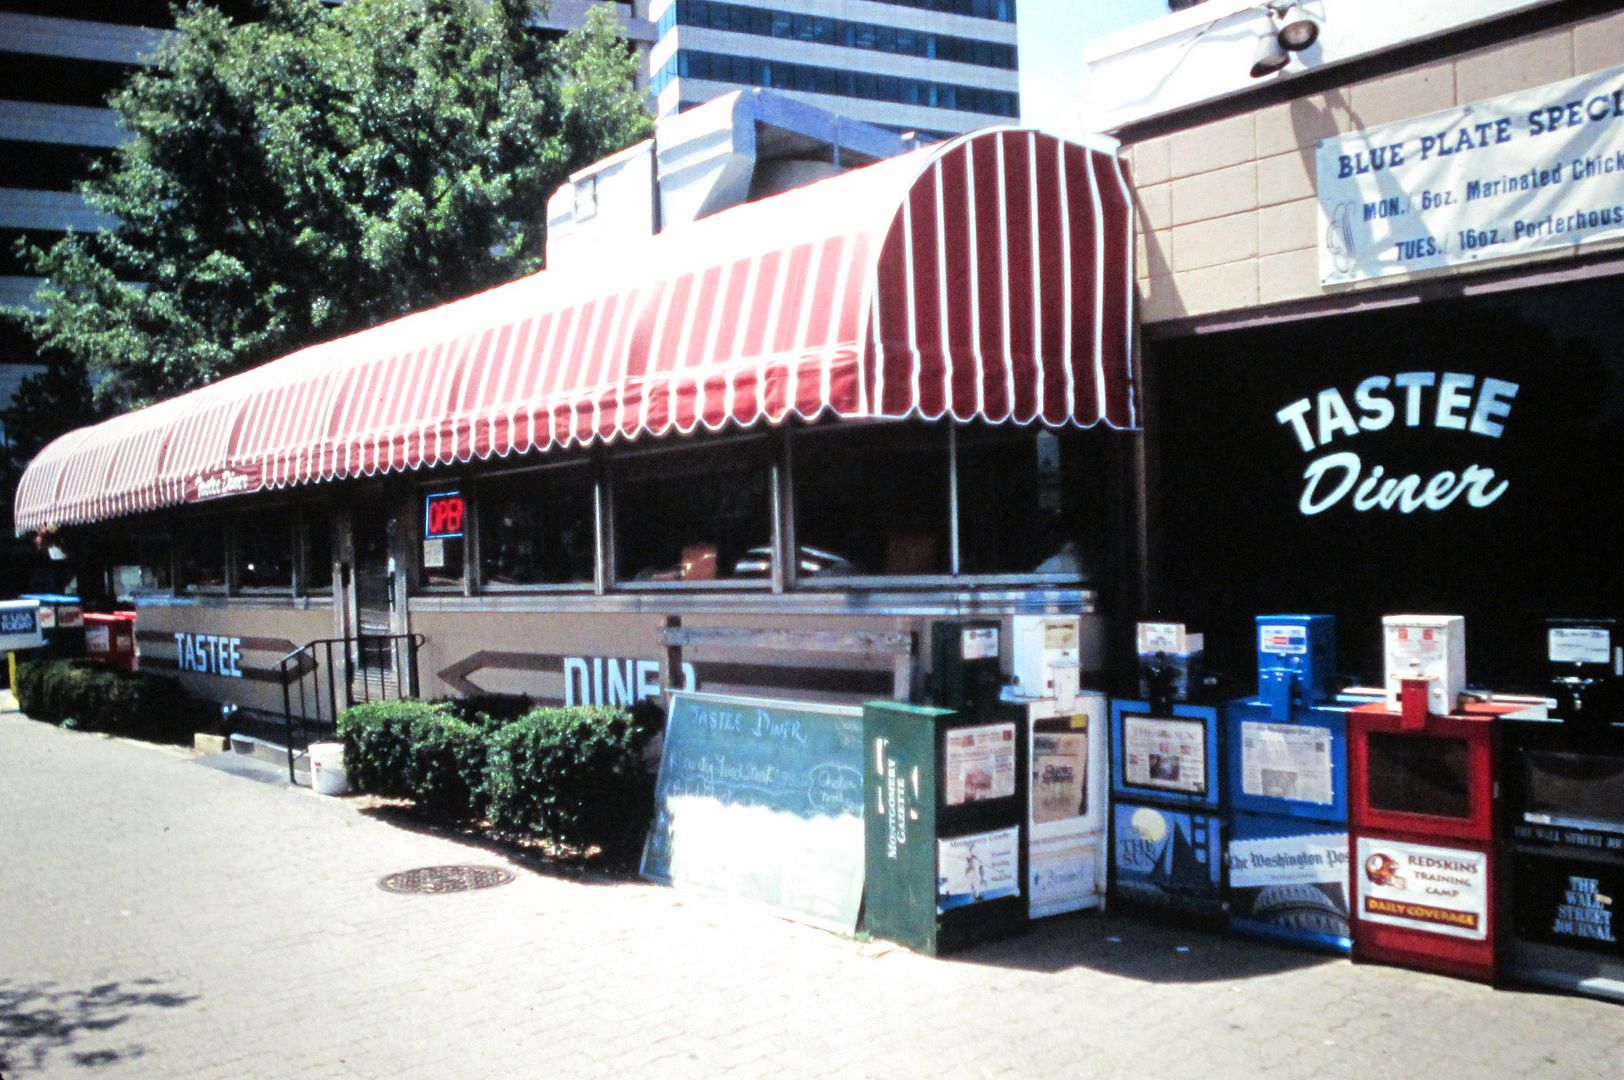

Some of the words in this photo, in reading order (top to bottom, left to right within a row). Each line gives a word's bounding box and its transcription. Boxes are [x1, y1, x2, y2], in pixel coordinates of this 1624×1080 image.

[1338, 143, 1405, 179] BLUE
[1420, 117, 1512, 161] PLATE
[1421, 190, 1458, 210] 6oz.
[1466, 163, 1563, 201] Marinated
[1459, 229, 1505, 251] 16oz.
[1275, 371, 1520, 452] TASTEE
[1299, 451, 1510, 516] Diner
[174, 632, 243, 678] TASTEE
[1250, 851, 1323, 870] Washington
[1408, 855, 1478, 875] REDSKINS
[1414, 871, 1472, 887] TRAINING
[1425, 885, 1460, 898] CAMP
[1367, 898, 1405, 914] DAILY
[1407, 905, 1475, 926] COVERAGE
